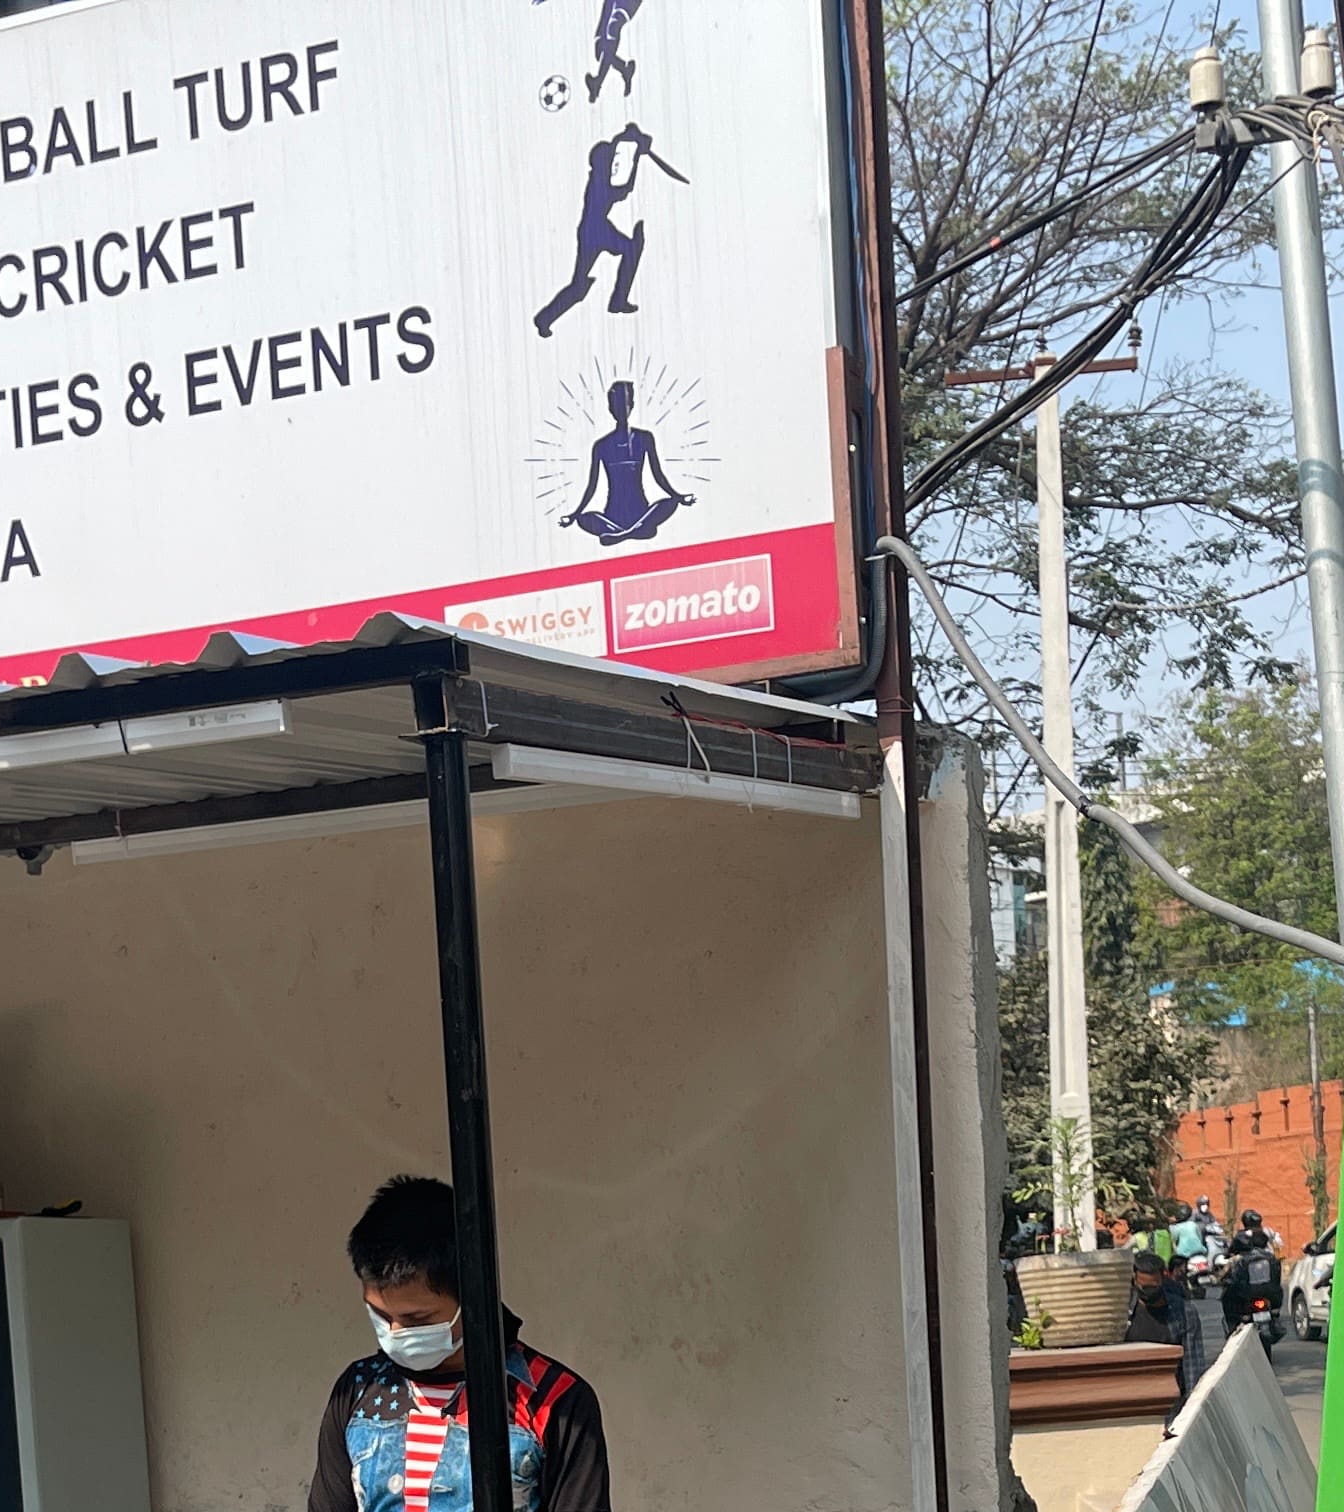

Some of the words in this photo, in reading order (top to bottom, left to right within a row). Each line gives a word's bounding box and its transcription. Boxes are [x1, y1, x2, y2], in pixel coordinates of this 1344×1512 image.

[174, 40, 338, 140] TURF
[125, 363, 165, 427] &
[185, 305, 435, 416] EVENTS
[494, 606, 593, 637] SWIGGY
[625, 580, 760, 631] zomato
